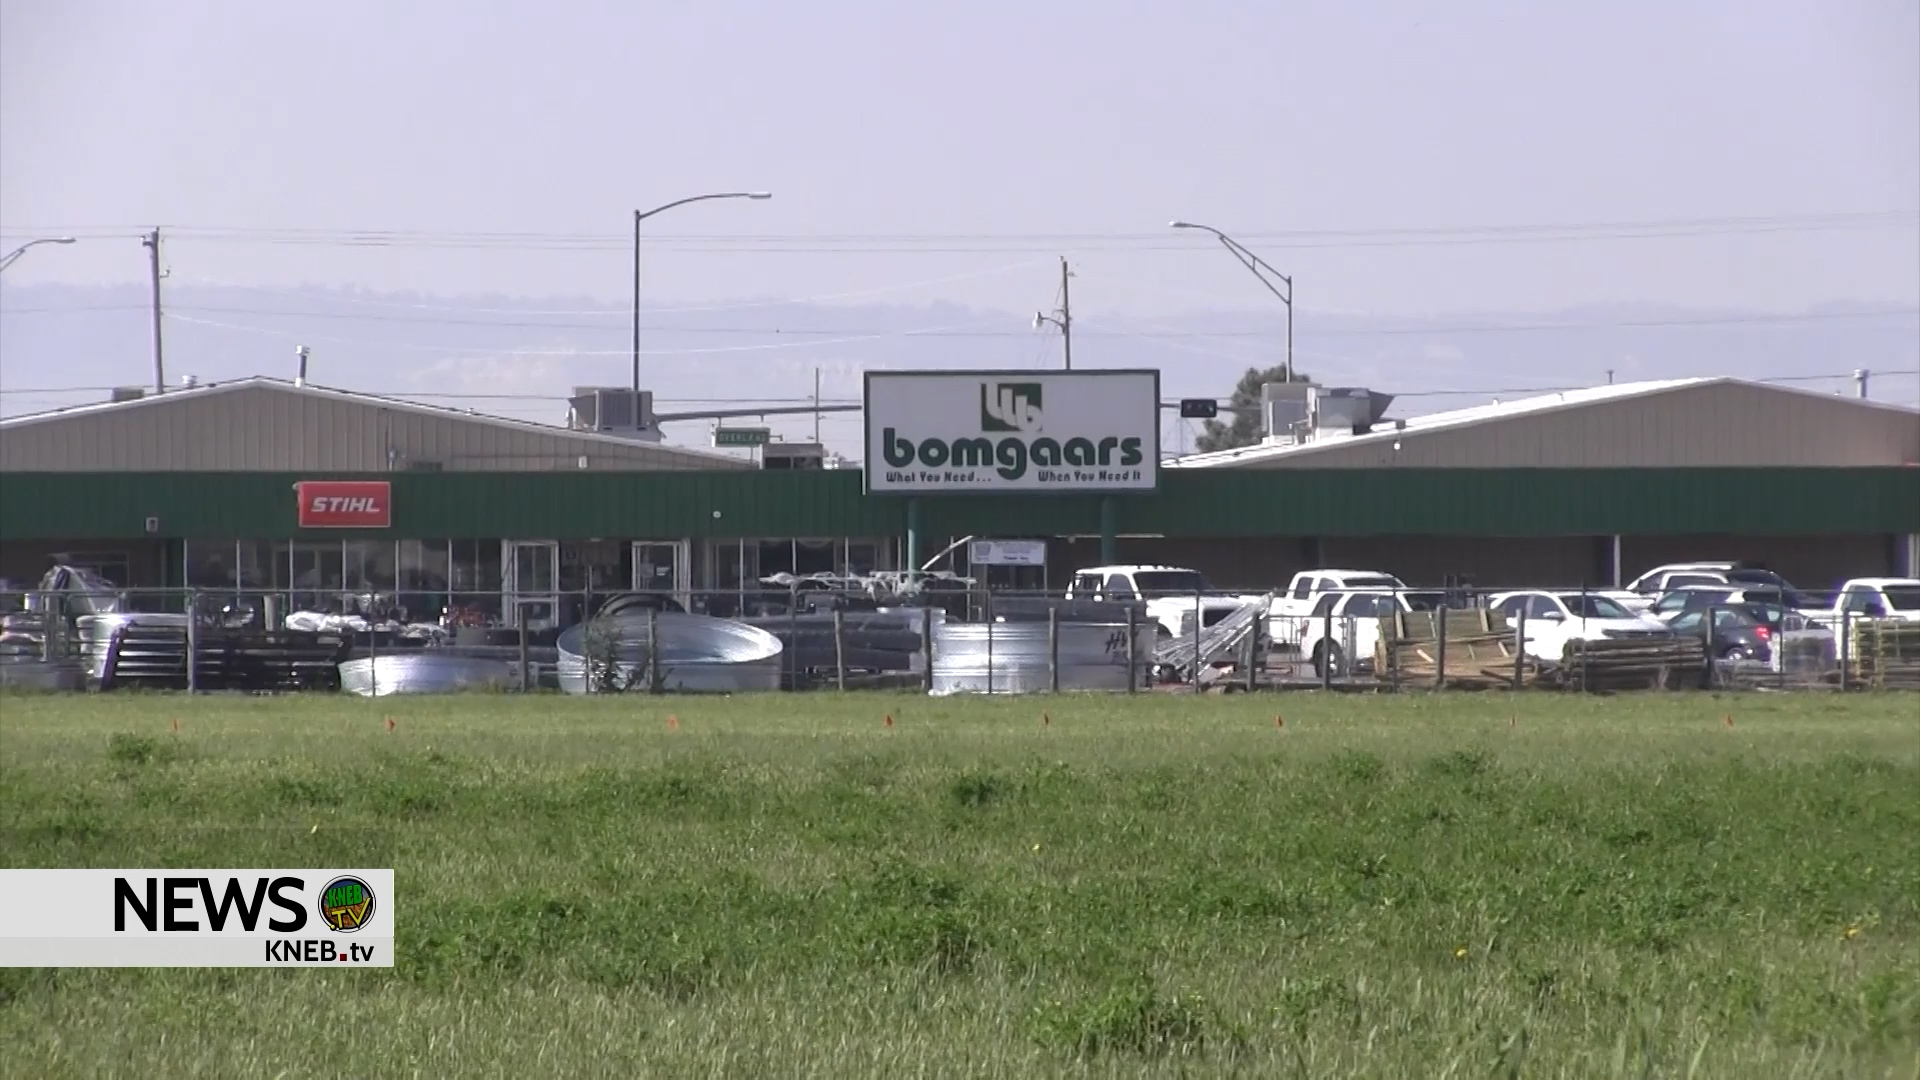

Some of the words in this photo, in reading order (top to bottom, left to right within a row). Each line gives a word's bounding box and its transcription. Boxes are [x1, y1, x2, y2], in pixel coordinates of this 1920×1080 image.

[883, 427, 1143, 480] bomgaars
[886, 471, 916, 482] What
[920, 471, 941, 482] You
[1038, 471, 1071, 482] When
[1074, 471, 1095, 482] You
[1099, 470, 1129, 481] Need
[1133, 470, 1142, 480] It
[310, 496, 380, 512] STIHL
